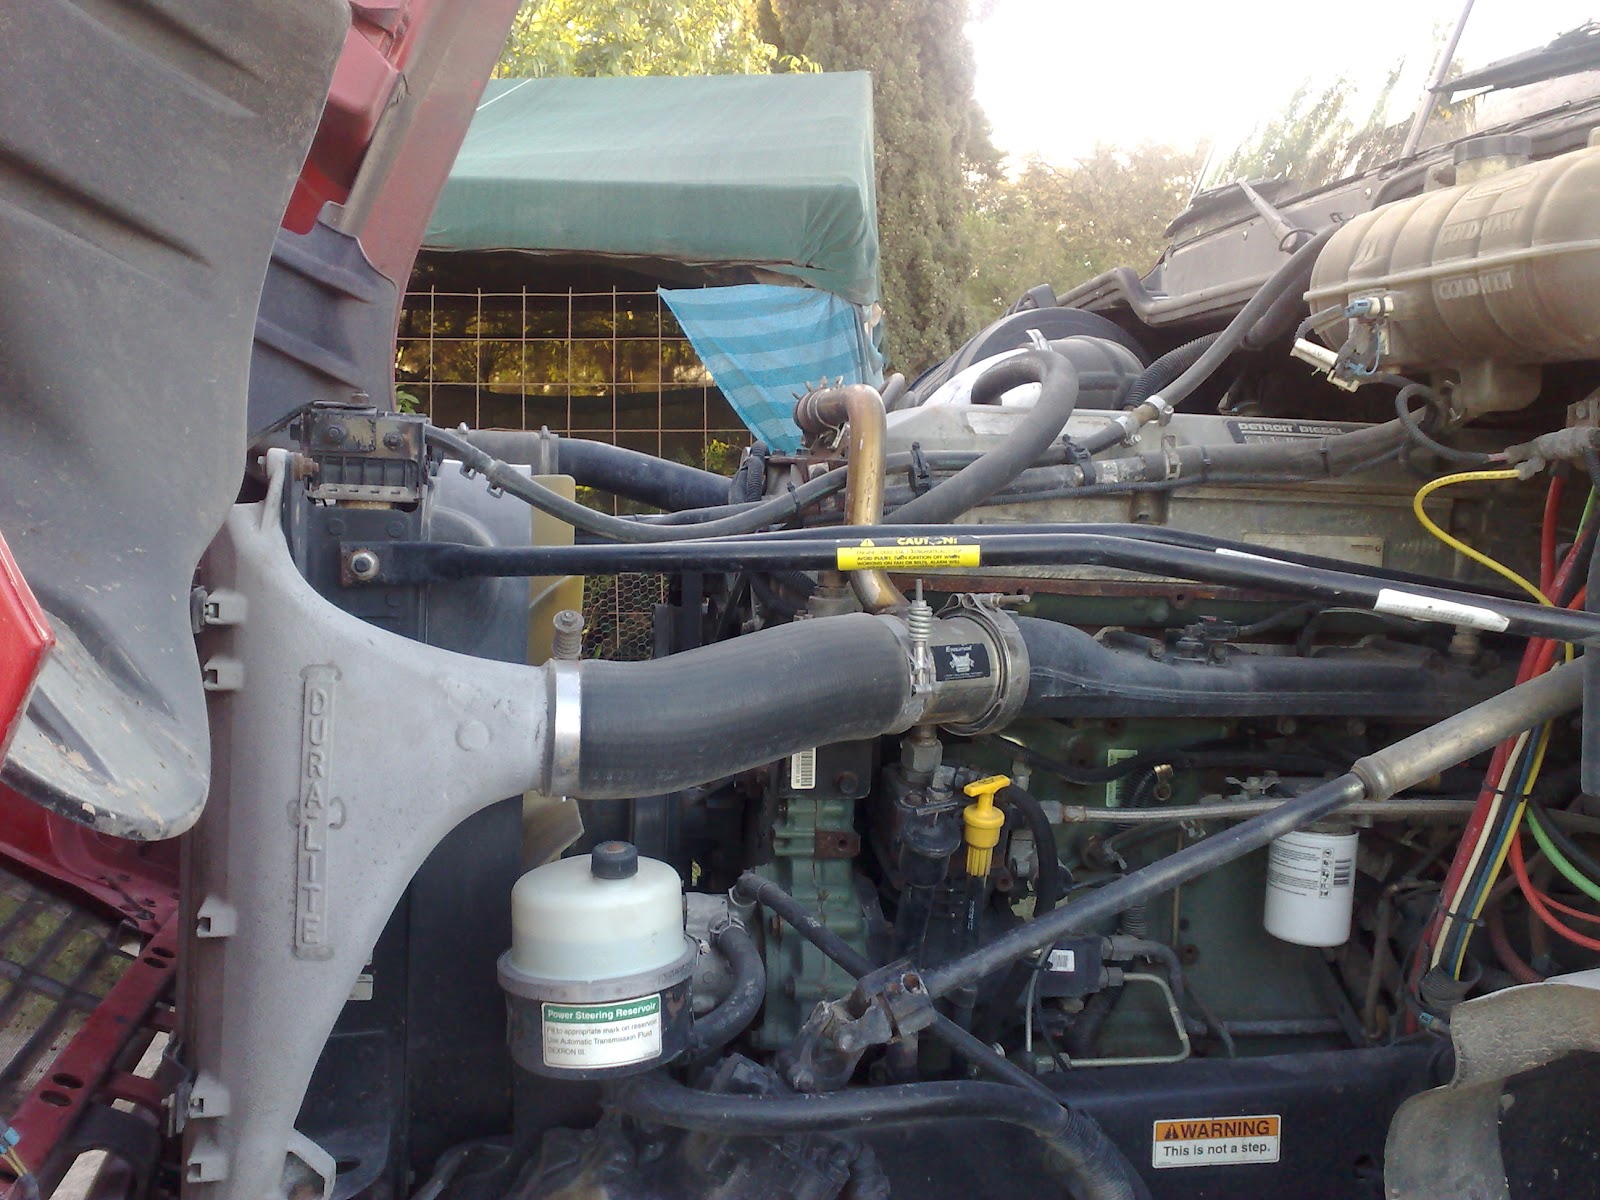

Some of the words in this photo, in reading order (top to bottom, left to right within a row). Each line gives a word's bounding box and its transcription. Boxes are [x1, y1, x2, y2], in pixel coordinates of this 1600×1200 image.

[1238, 422, 1293, 433] DETROIT
[1299, 425, 1343, 435] DIESEL
[896, 536, 958, 546] CAUTON:
[302, 687, 326, 945] DURA-LITE
[547, 1009, 574, 1019] Power
[575, 1010, 614, 1021] Steering
[615, 1002, 657, 1017] Reservoir
[560, 1037, 592, 1045] Automatic
[594, 1034, 636, 1045] Transmission
[637, 1030, 653, 1039] Fluid
[564, 1026, 602, 1036] appropriate
[602, 1026, 620, 1034] mark
[547, 1047, 577, 1055] DEXRON
[1180, 1120, 1270, 1139] WARNING
[1164, 1145, 1190, 1157] This
[1193, 1144, 1203, 1155] is
[1207, 1143, 1227, 1155] not
[1230, 1145, 1238, 1154] a
[1241, 1142, 1271, 1155] step.
